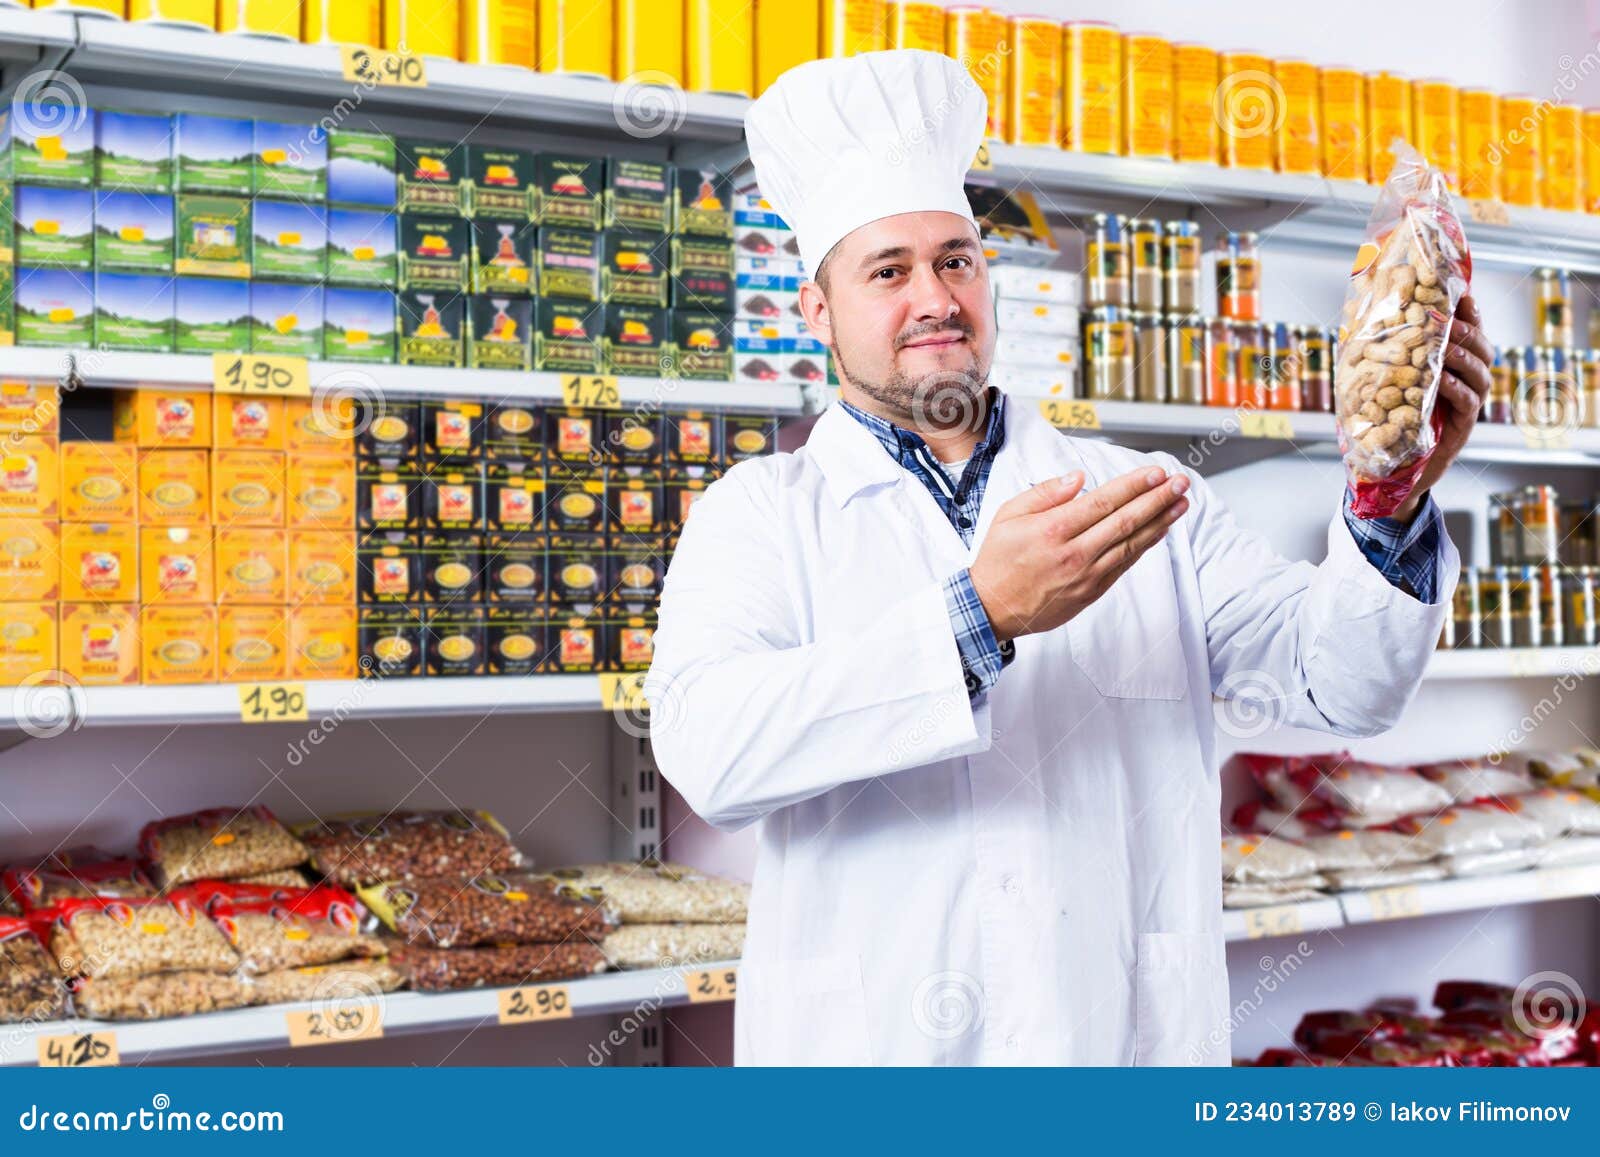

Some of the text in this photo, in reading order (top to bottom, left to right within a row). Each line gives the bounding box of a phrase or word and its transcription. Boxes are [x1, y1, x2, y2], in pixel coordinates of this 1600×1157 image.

[225, 359, 292, 391] 1,90
[568, 376, 619, 408] 1,20
[1048, 402, 1095, 427] 2,50
[244, 686, 304, 722] 1,90
[507, 990, 568, 1017] 2,90
[47, 1034, 110, 1066] 4,20
